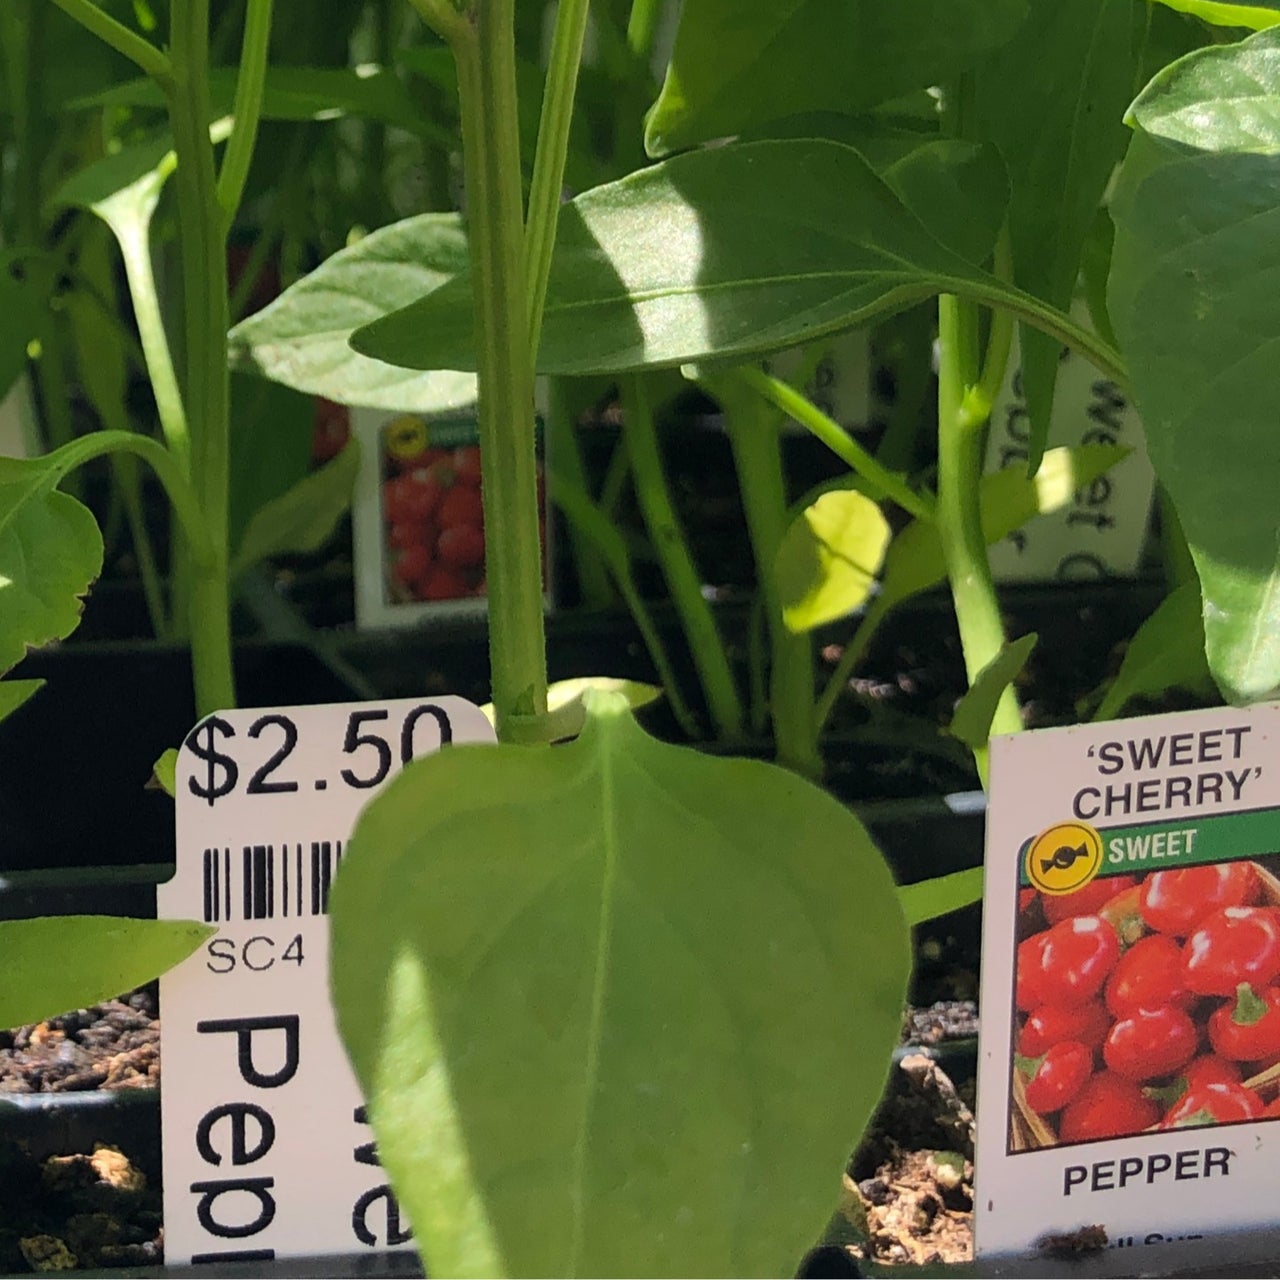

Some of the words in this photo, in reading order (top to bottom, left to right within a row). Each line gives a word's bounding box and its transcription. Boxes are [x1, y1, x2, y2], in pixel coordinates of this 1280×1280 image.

[1087, 726, 1252, 776] 'SWEET
[1072, 768, 1262, 820] CHERRY'
[1108, 829, 1198, 864] SWEET
[206, 934, 305, 973] SC4
[189, 1014, 301, 1265] Pep
[1063, 1146, 1231, 1197] PEPPER
